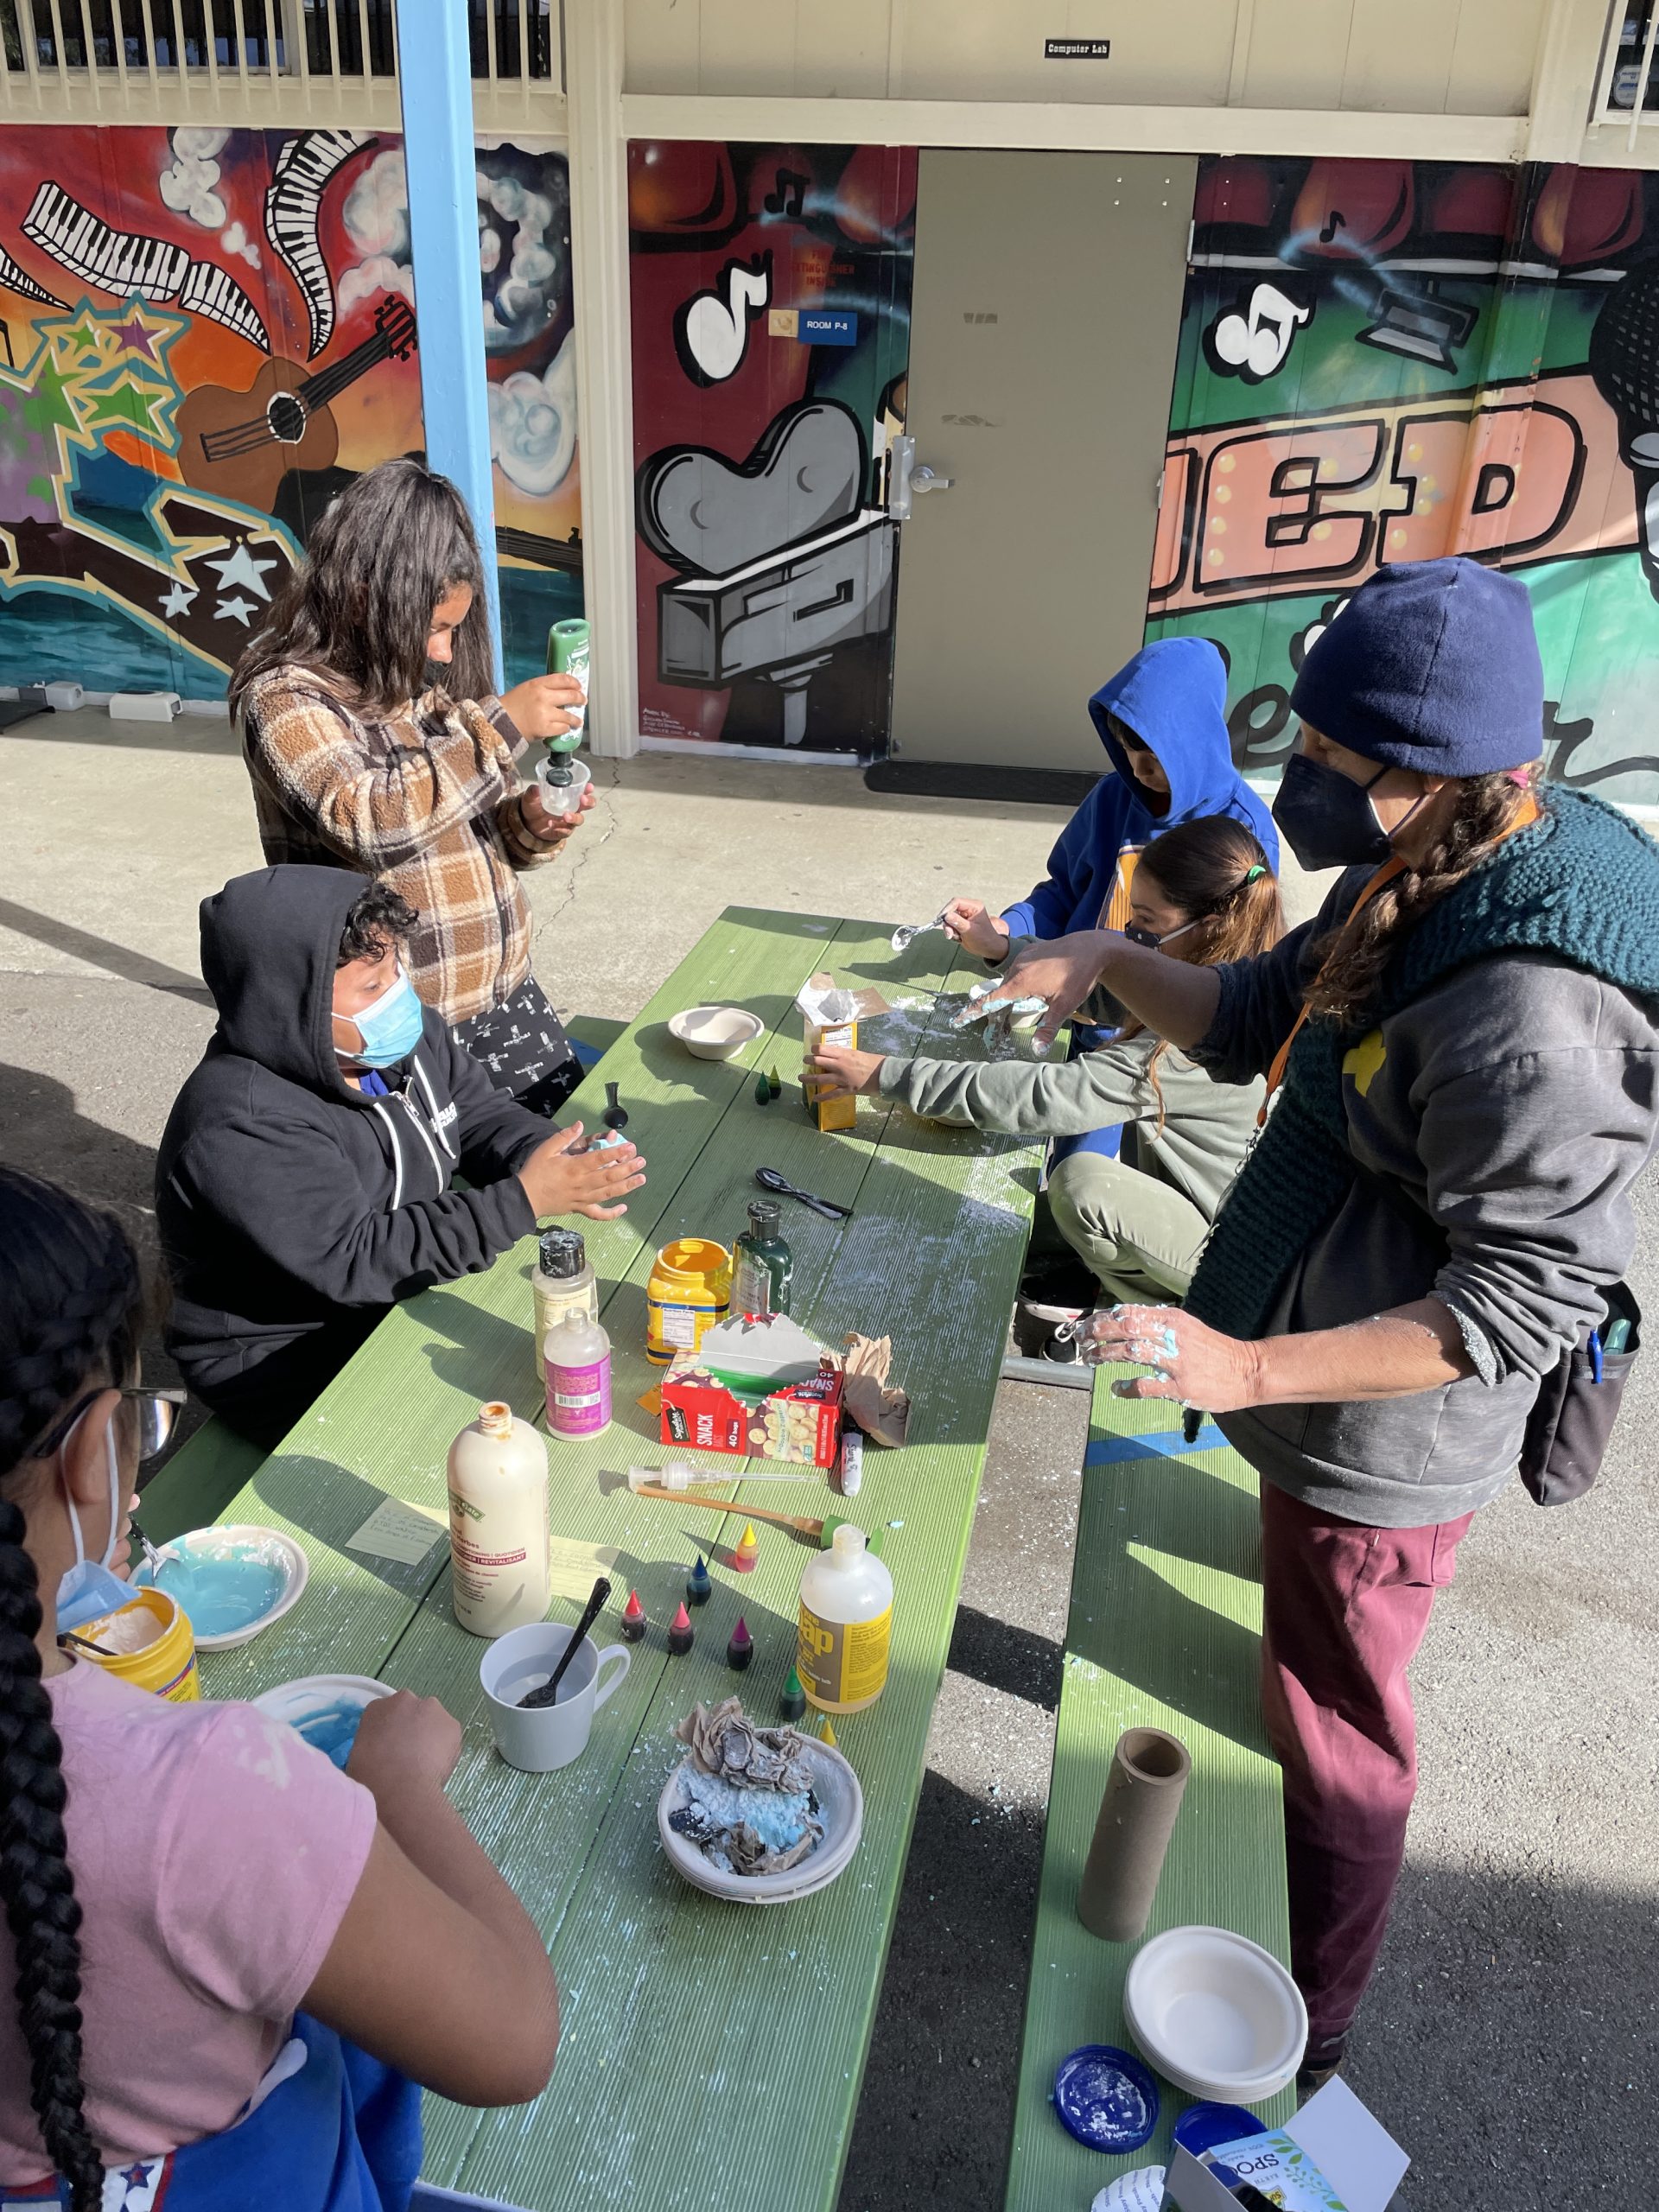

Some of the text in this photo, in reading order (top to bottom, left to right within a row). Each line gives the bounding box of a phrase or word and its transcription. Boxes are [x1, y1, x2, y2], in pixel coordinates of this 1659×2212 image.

[1048, 43, 1107, 55] Computer Lab
[806, 321, 848, 331] ROOM P-8
[671, 1411, 683, 1440] Signature
[696, 1414, 713, 1446] SNACK
[728, 1433, 738, 1446] 40
[480, 1553, 525, 1566] REVITALISANT
